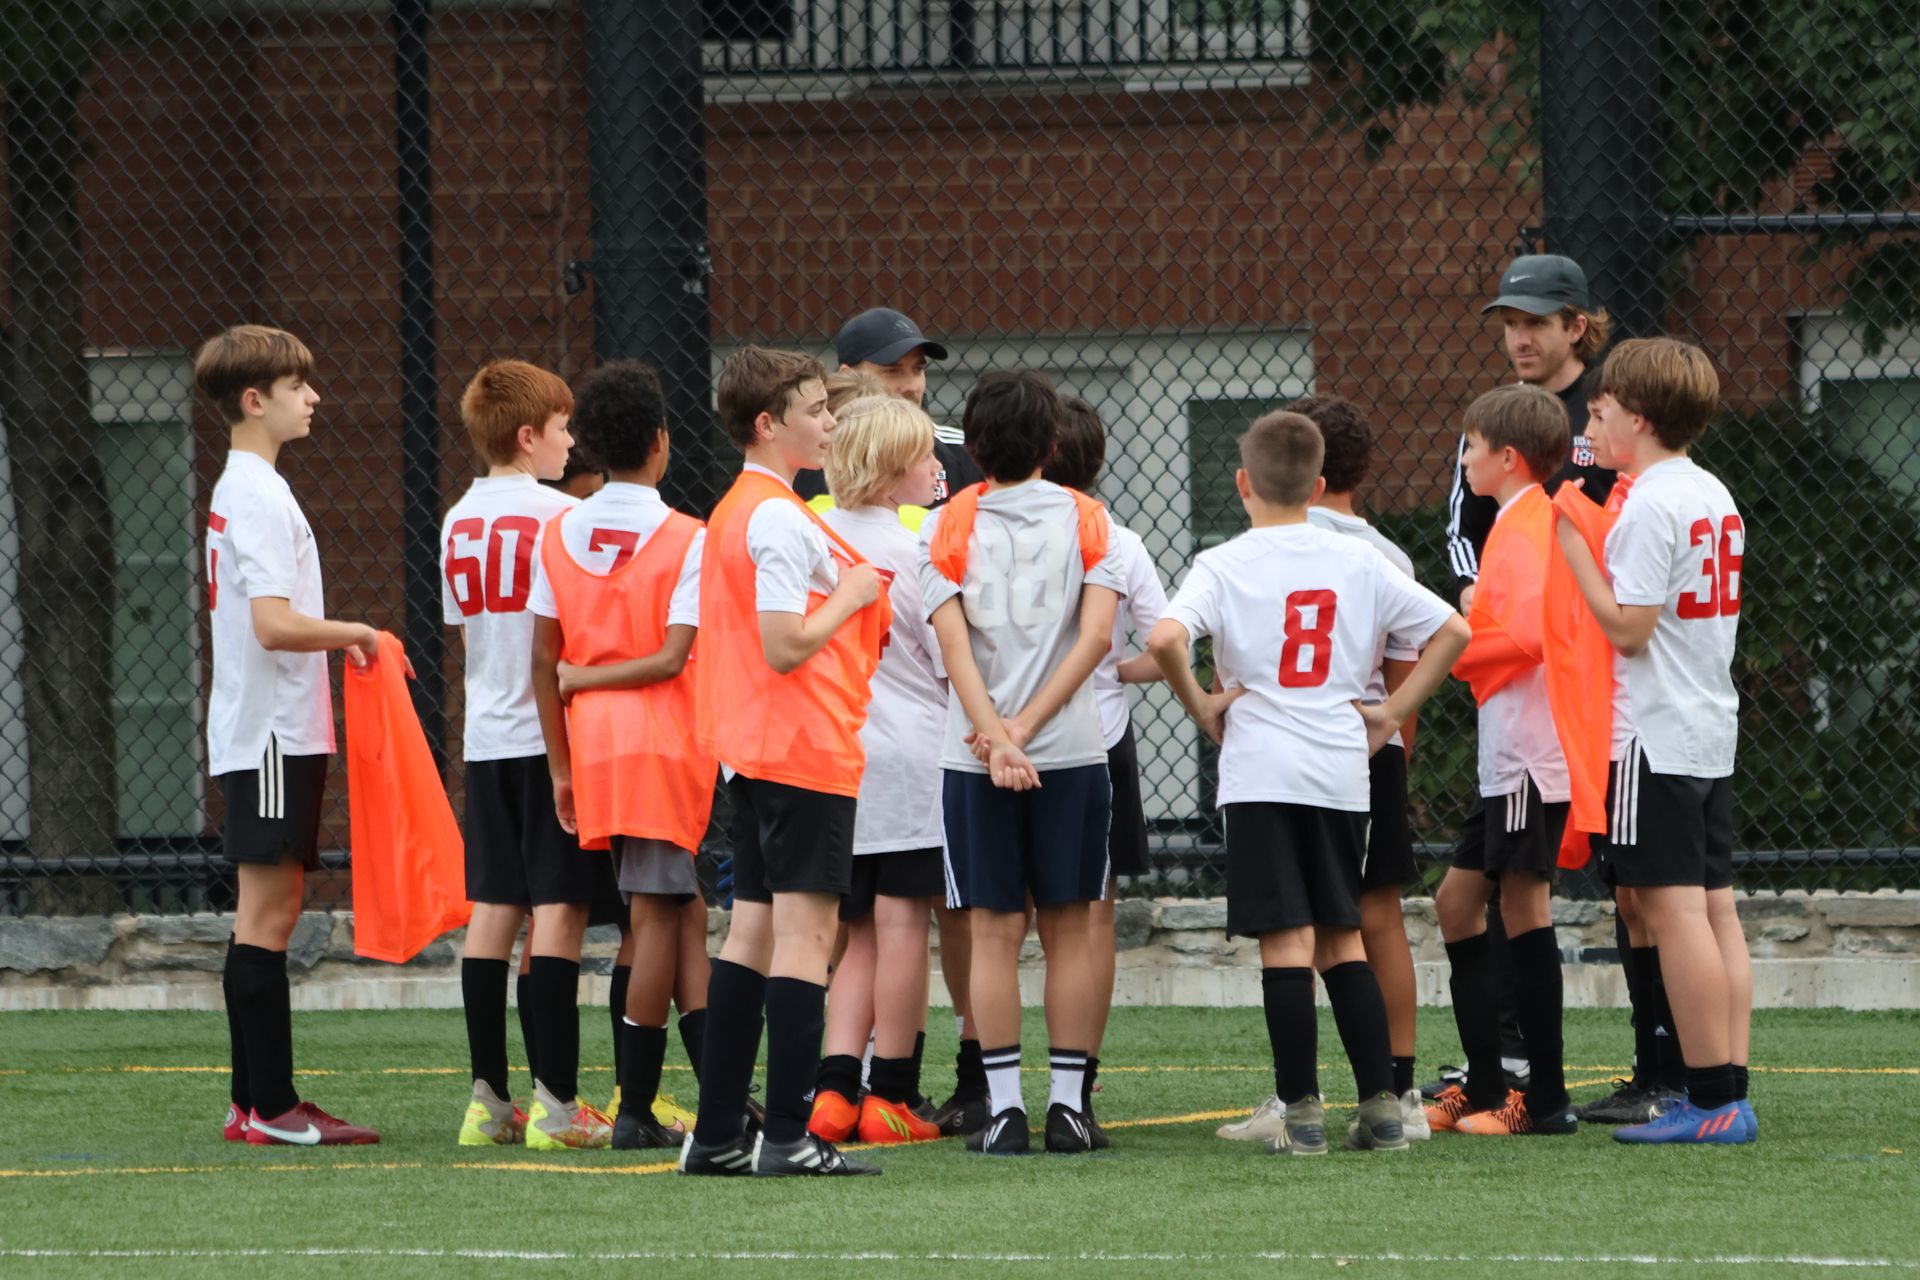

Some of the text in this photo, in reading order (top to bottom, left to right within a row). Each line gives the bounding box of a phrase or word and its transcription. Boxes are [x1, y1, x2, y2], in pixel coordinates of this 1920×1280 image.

[445, 515, 540, 617] 60
[588, 527, 641, 575] 7
[1676, 515, 1743, 620] 36
[1278, 589, 1337, 689] 8
